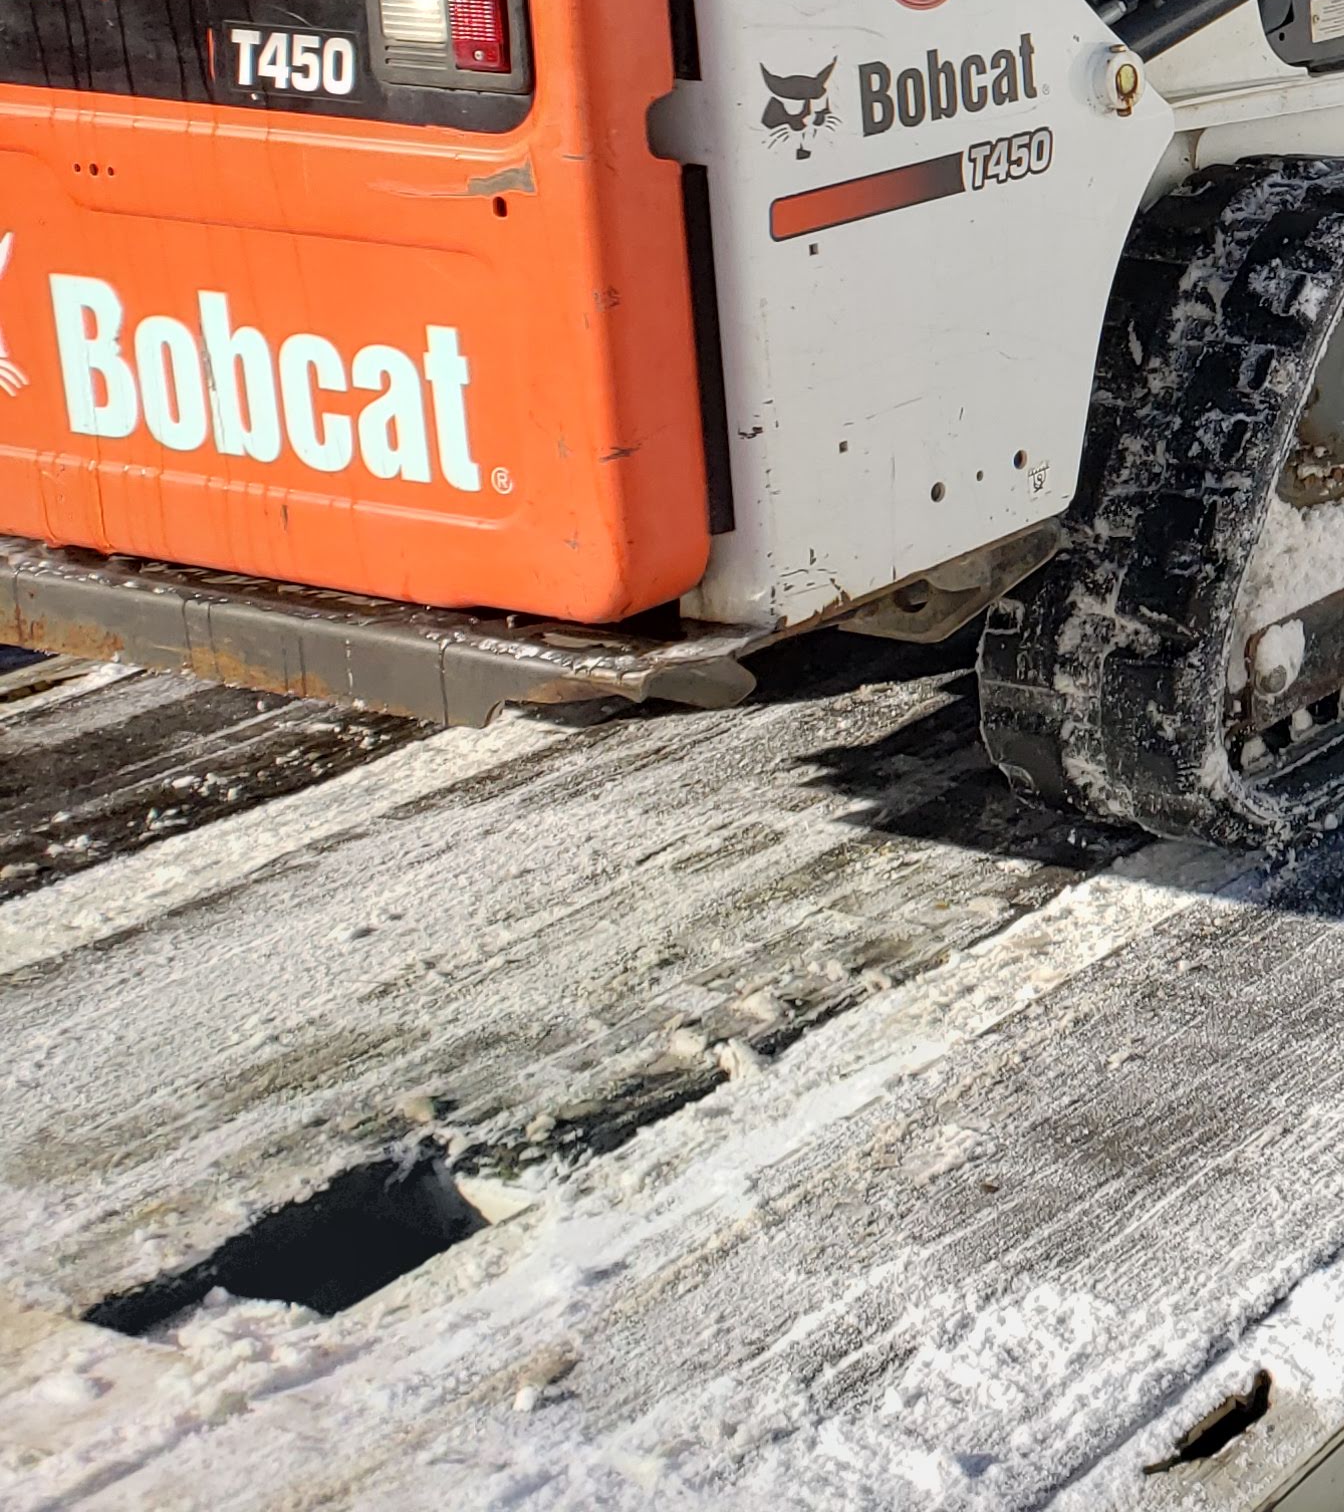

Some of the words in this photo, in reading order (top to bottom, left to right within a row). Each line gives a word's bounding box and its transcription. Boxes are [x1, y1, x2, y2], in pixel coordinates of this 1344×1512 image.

[231, 28, 355, 94] T450
[858, 33, 1037, 137] Bobcat
[968, 126, 1052, 191] T450
[49, 274, 482, 492] Bobcat
